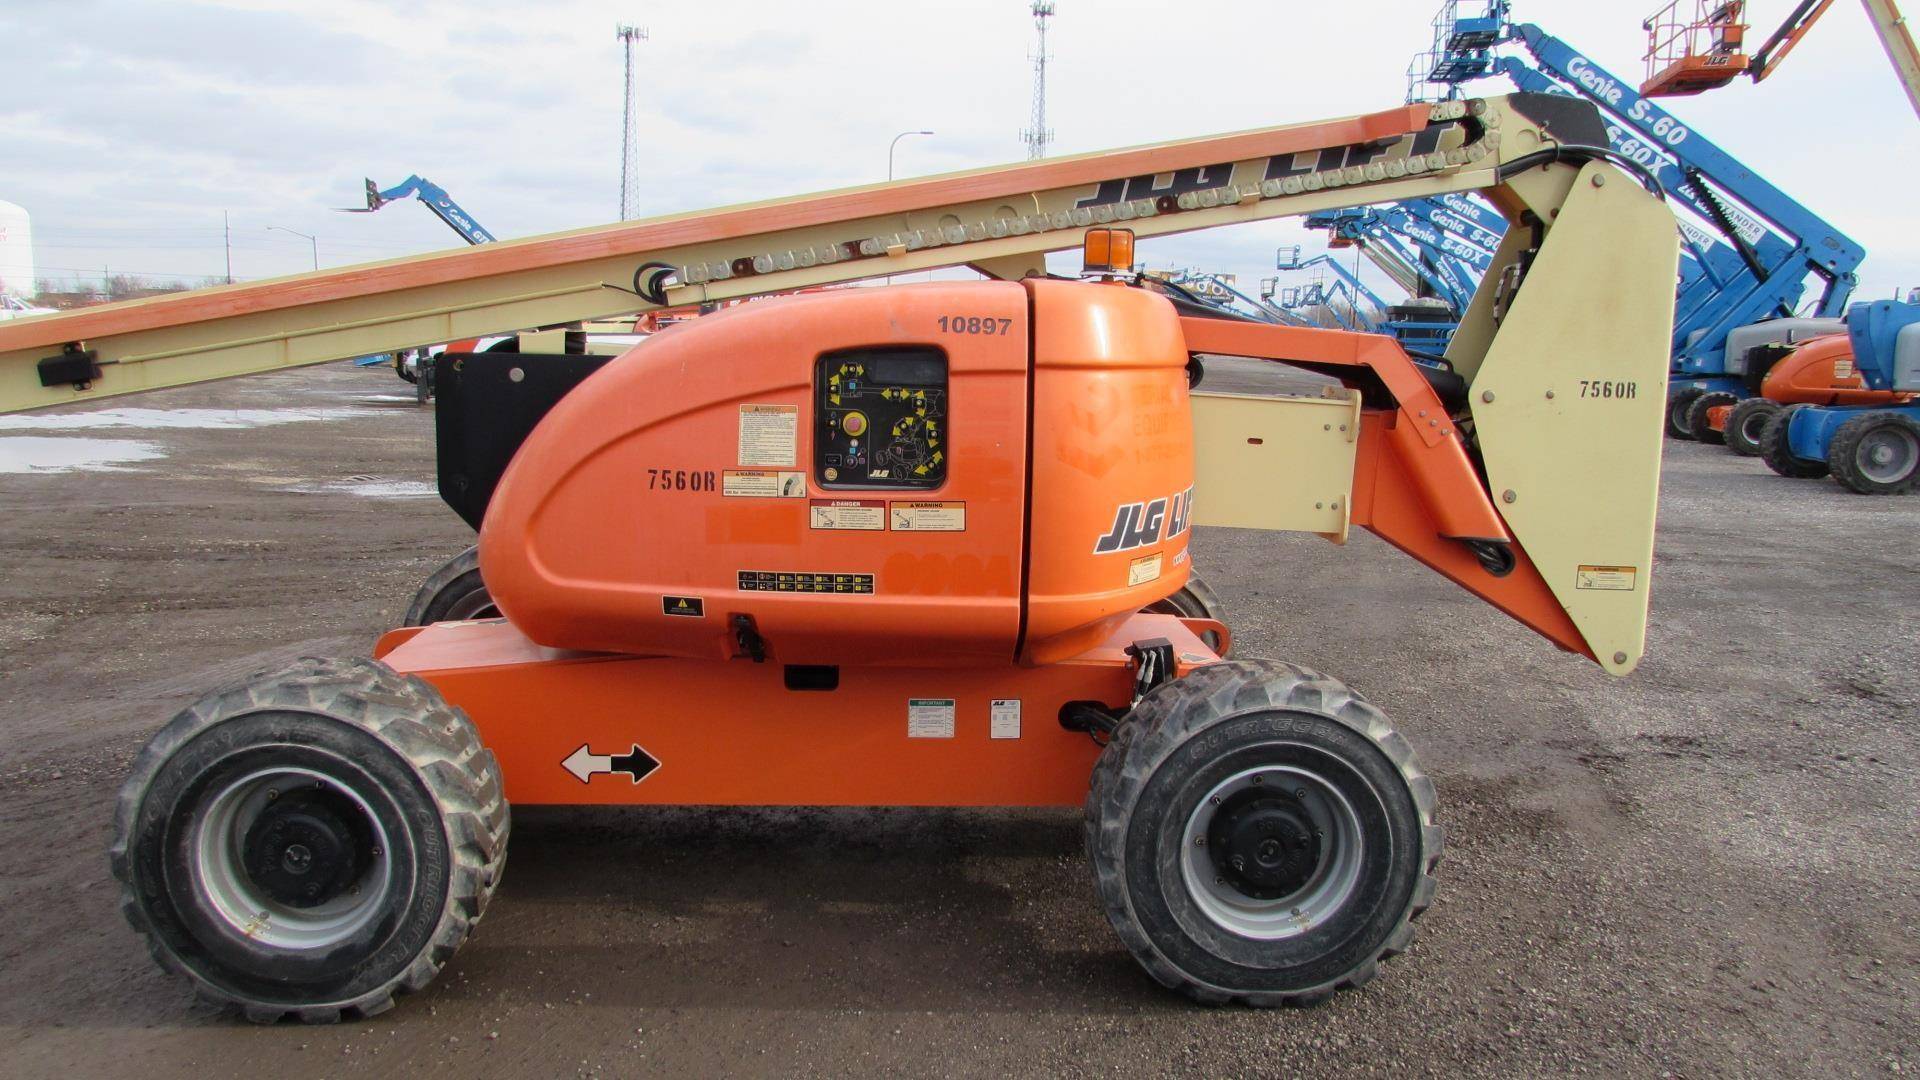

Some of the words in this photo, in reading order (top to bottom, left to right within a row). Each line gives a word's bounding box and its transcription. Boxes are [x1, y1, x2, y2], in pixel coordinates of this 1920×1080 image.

[1567, 57, 1622, 105] Genie
[1628, 99, 1687, 145] S-60
[1443, 194, 1480, 221] Genie
[449, 208, 473, 233] Genie
[1430, 209, 1465, 233] Genie
[1403, 221, 1436, 244] Genie
[1441, 239, 1484, 265] S-60X
[938, 315, 1012, 336] 10897
[1580, 380, 1637, 399] 7560R
[648, 469, 716, 492] 7560R
[870, 469, 890, 478] JLG
[1093, 497, 1168, 555] JLG
